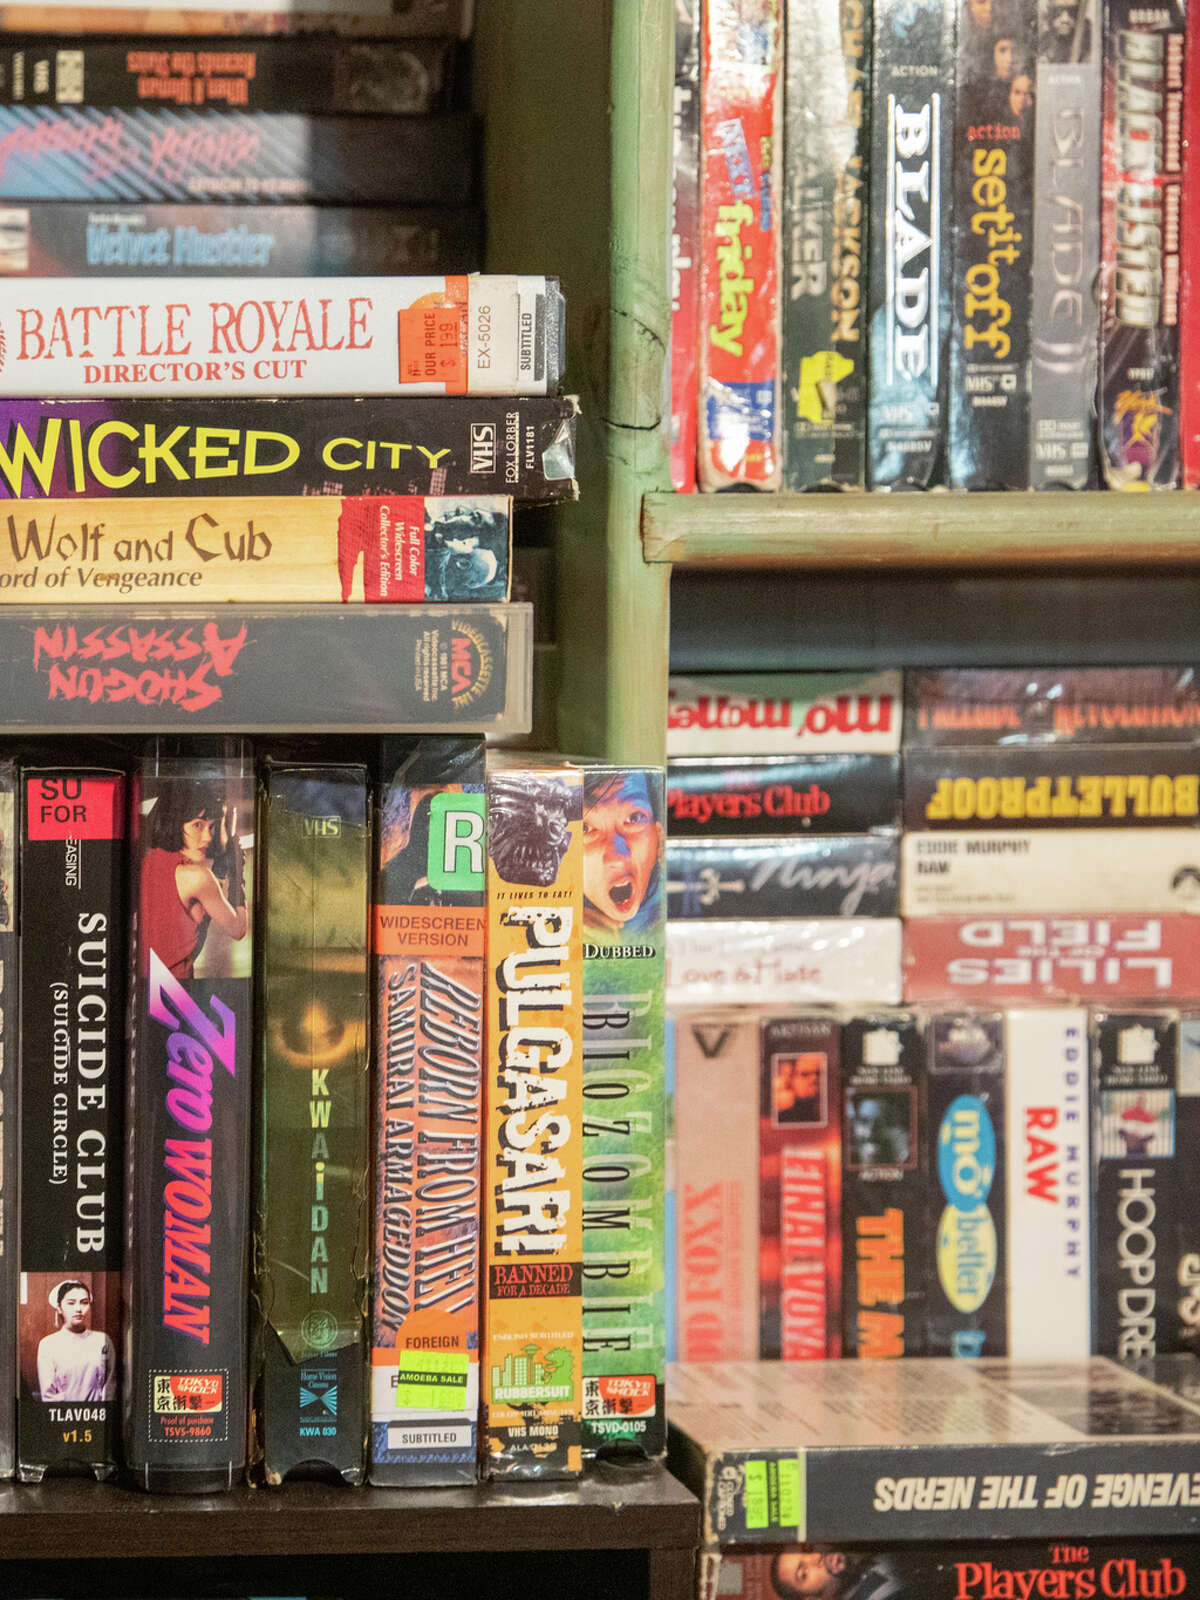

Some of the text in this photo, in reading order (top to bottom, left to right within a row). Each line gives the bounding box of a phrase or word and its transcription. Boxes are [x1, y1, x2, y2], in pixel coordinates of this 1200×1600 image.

[891, 66, 937, 77] ACTION
[968, 125, 1020, 139] action
[971, 149, 1005, 234] set
[895, 104, 931, 380] BLADE
[710, 199, 755, 357] friday
[16, 297, 374, 361] BATTLE ROYALE
[965, 265, 1011, 358] off
[424, 312, 437, 376] OUR PRICE
[477, 304, 492, 369] EX-5026
[520, 312, 532, 371] SUBTITLED
[83, 358, 307, 384] DIRECTOR'S CUT
[323, 436, 450, 471] CITY
[474, 425, 493, 470] VHS
[505, 412, 519, 483] FOX LORBER
[524, 425, 536, 471] FLV1181
[7, 514, 109, 563] Wolf
[114, 529, 174, 563] and
[185, 513, 273, 563] Cub
[379, 505, 391, 597] Collector's Edition
[394, 521, 405, 581] Widescreen
[408, 525, 420, 577] Full Color
[44, 566, 70, 588] of
[74, 568, 203, 594] Vengeance
[34, 621, 249, 677] ASSASSIN
[451, 637, 472, 695] MCA
[48, 665, 224, 713] SHOGUN
[40, 779, 84, 800] SU
[927, 776, 1198, 820] BULLETPROOF
[40, 804, 87, 823] FOR
[304, 818, 339, 836] VHS
[443, 810, 485, 874] R
[966, 839, 1030, 855] MURPHY
[749, 857, 896, 915] Ninja
[380, 916, 486, 932] WIDESCREEN
[398, 932, 469, 947] VERSION
[961, 919, 1162, 951] FIELD
[585, 943, 656, 959] DUBBED
[947, 957, 1173, 989] LILIES
[417, 961, 482, 1127] REBORN
[48, 981, 69, 1185] (SUICIDE CIRCLE)
[76, 912, 108, 1254] SUICIDE CLUB
[495, 905, 573, 1257] PULGASARI
[148, 946, 237, 1345] Zero WOMAN
[377, 962, 418, 1333] SAMURAI ARMAGEDDON
[1024, 1106, 1060, 1204] RAW
[1064, 1027, 1082, 1279] EDDIE MURPHY
[415, 1130, 480, 1238] FROM
[494, 1264, 574, 1285] BANNED
[856, 1208, 904, 1305] THE
[405, 1335, 460, 1349] FOREIGN
[399, 1372, 464, 1384] AMOEBA SALE
[494, 1384, 571, 1401] RUBBERSUIT
[48, 1407, 107, 1422] TLAV048
[62, 1429, 93, 1444] v1.5
[591, 1420, 647, 1434] TSVD-0105
[401, 1432, 458, 1444] SUBTITLED
[874, 1477, 975, 1512] NERDS
[980, 1476, 1038, 1511] THE
[1044, 1474, 1087, 1510] OF
[1048, 1543, 1089, 1565] The
[954, 1556, 1187, 1600] Players Club
